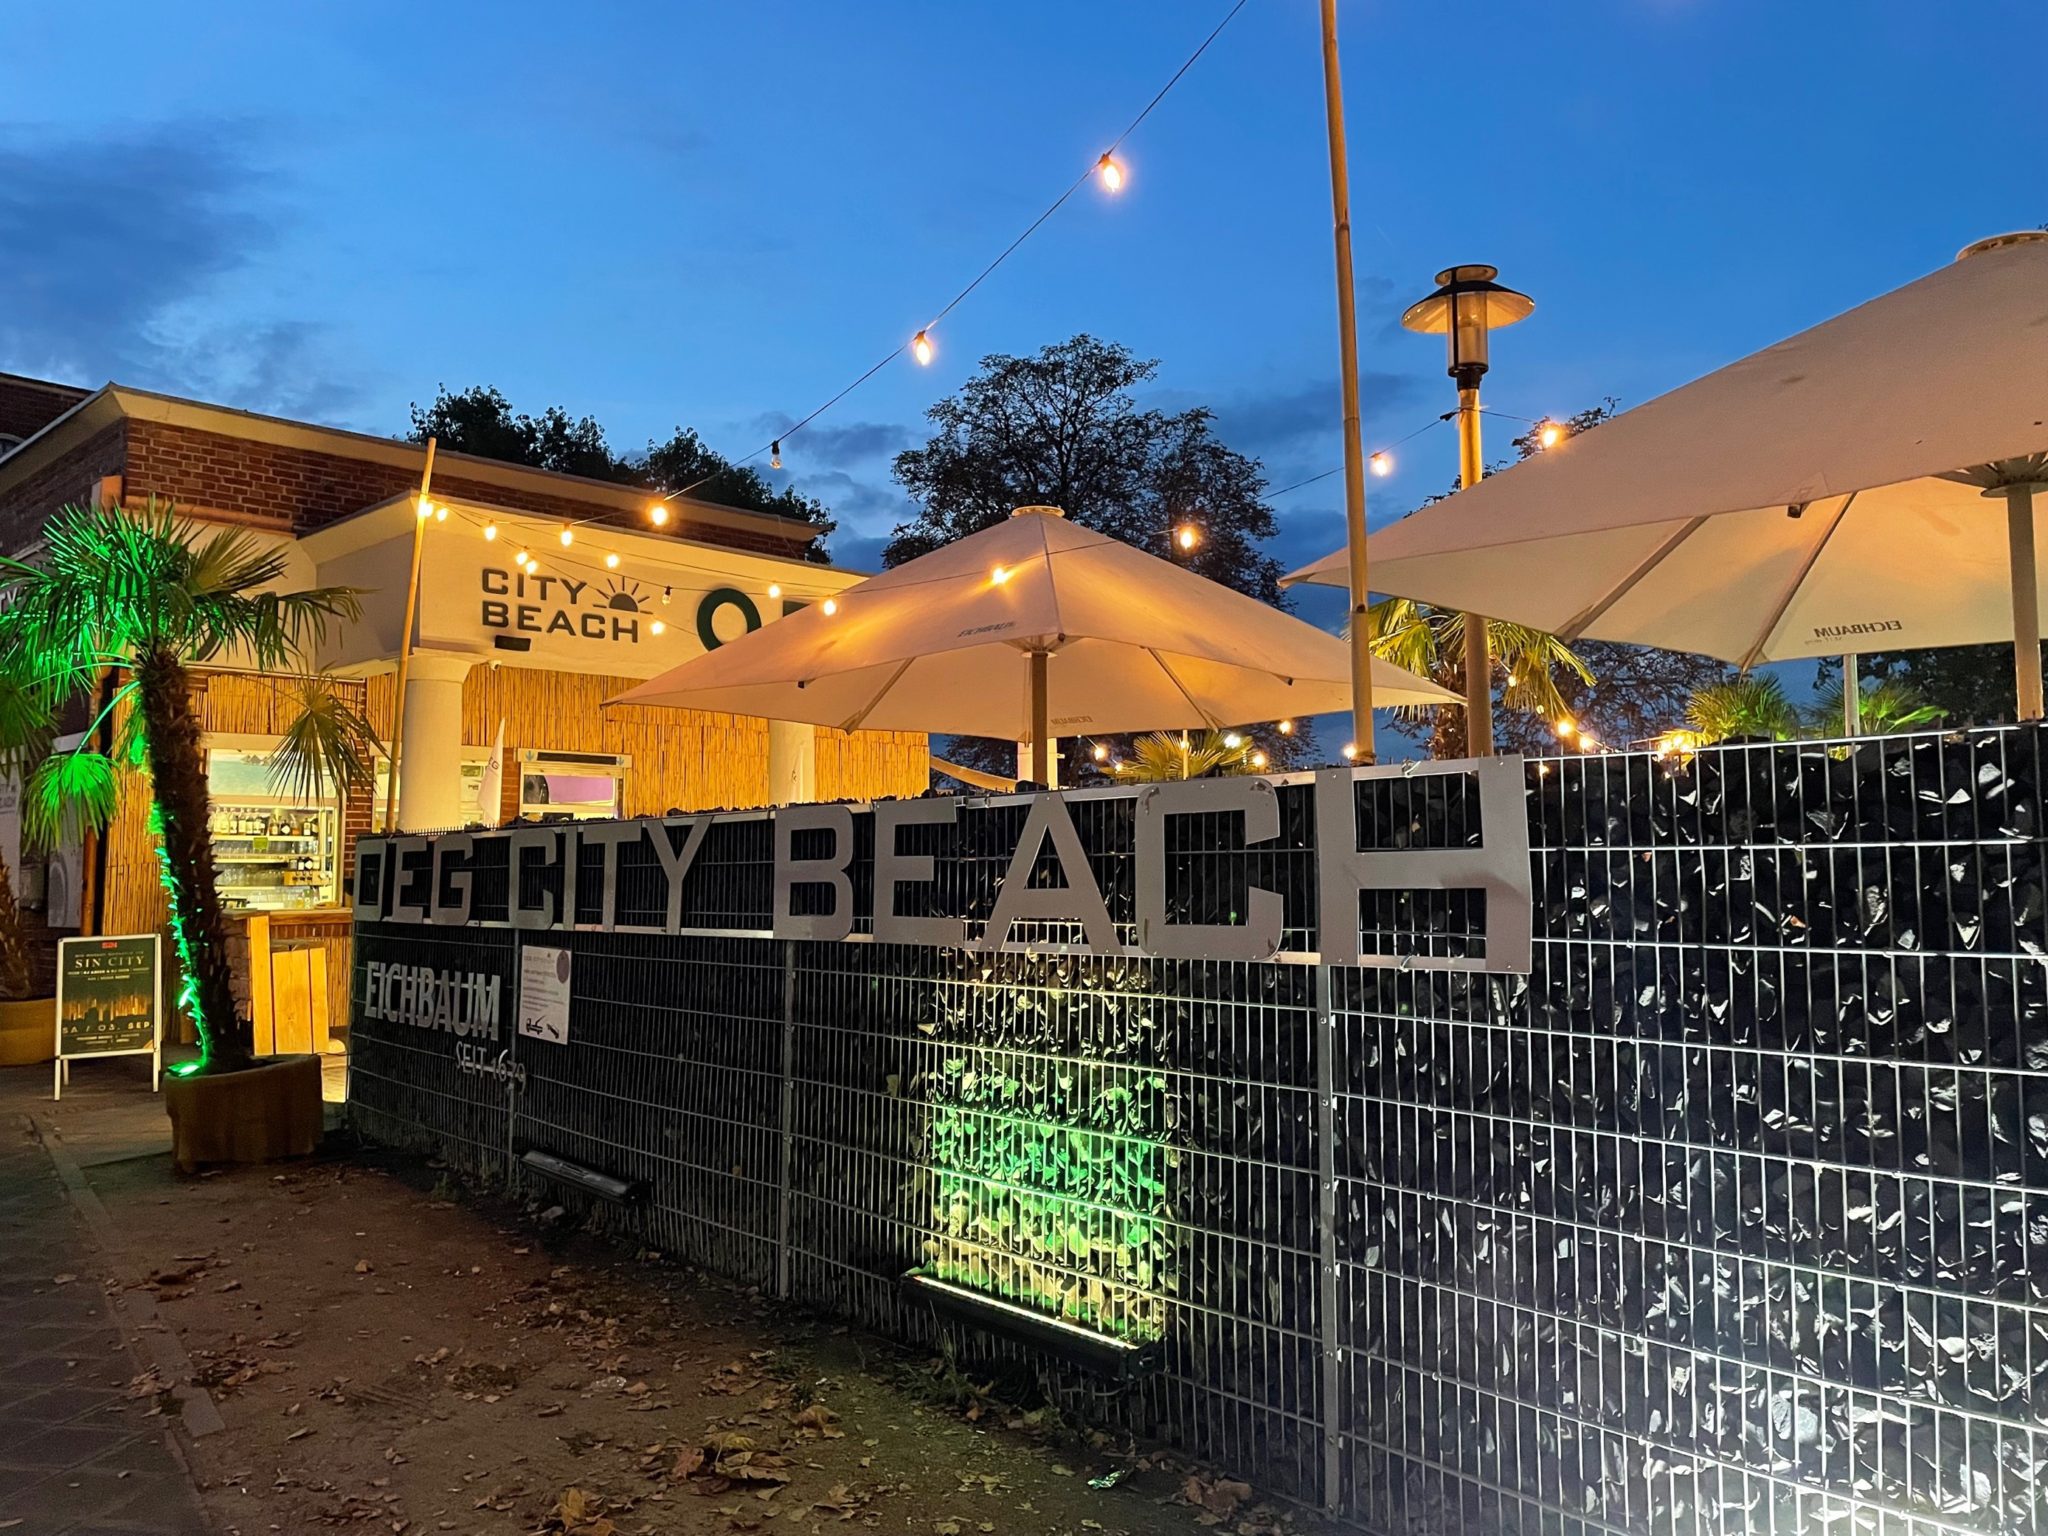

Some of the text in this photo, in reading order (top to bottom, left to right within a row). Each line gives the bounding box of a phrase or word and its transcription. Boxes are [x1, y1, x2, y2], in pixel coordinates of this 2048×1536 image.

[482, 568, 588, 605] CITY
[481, 600, 639, 643] BEACH
[354, 754, 1532, 975] OEG CITY BEACH
[75, 955, 144, 968] SIN CITY
[364, 961, 501, 1041] EICHBAUM
[455, 1041, 488, 1079] SEIT
